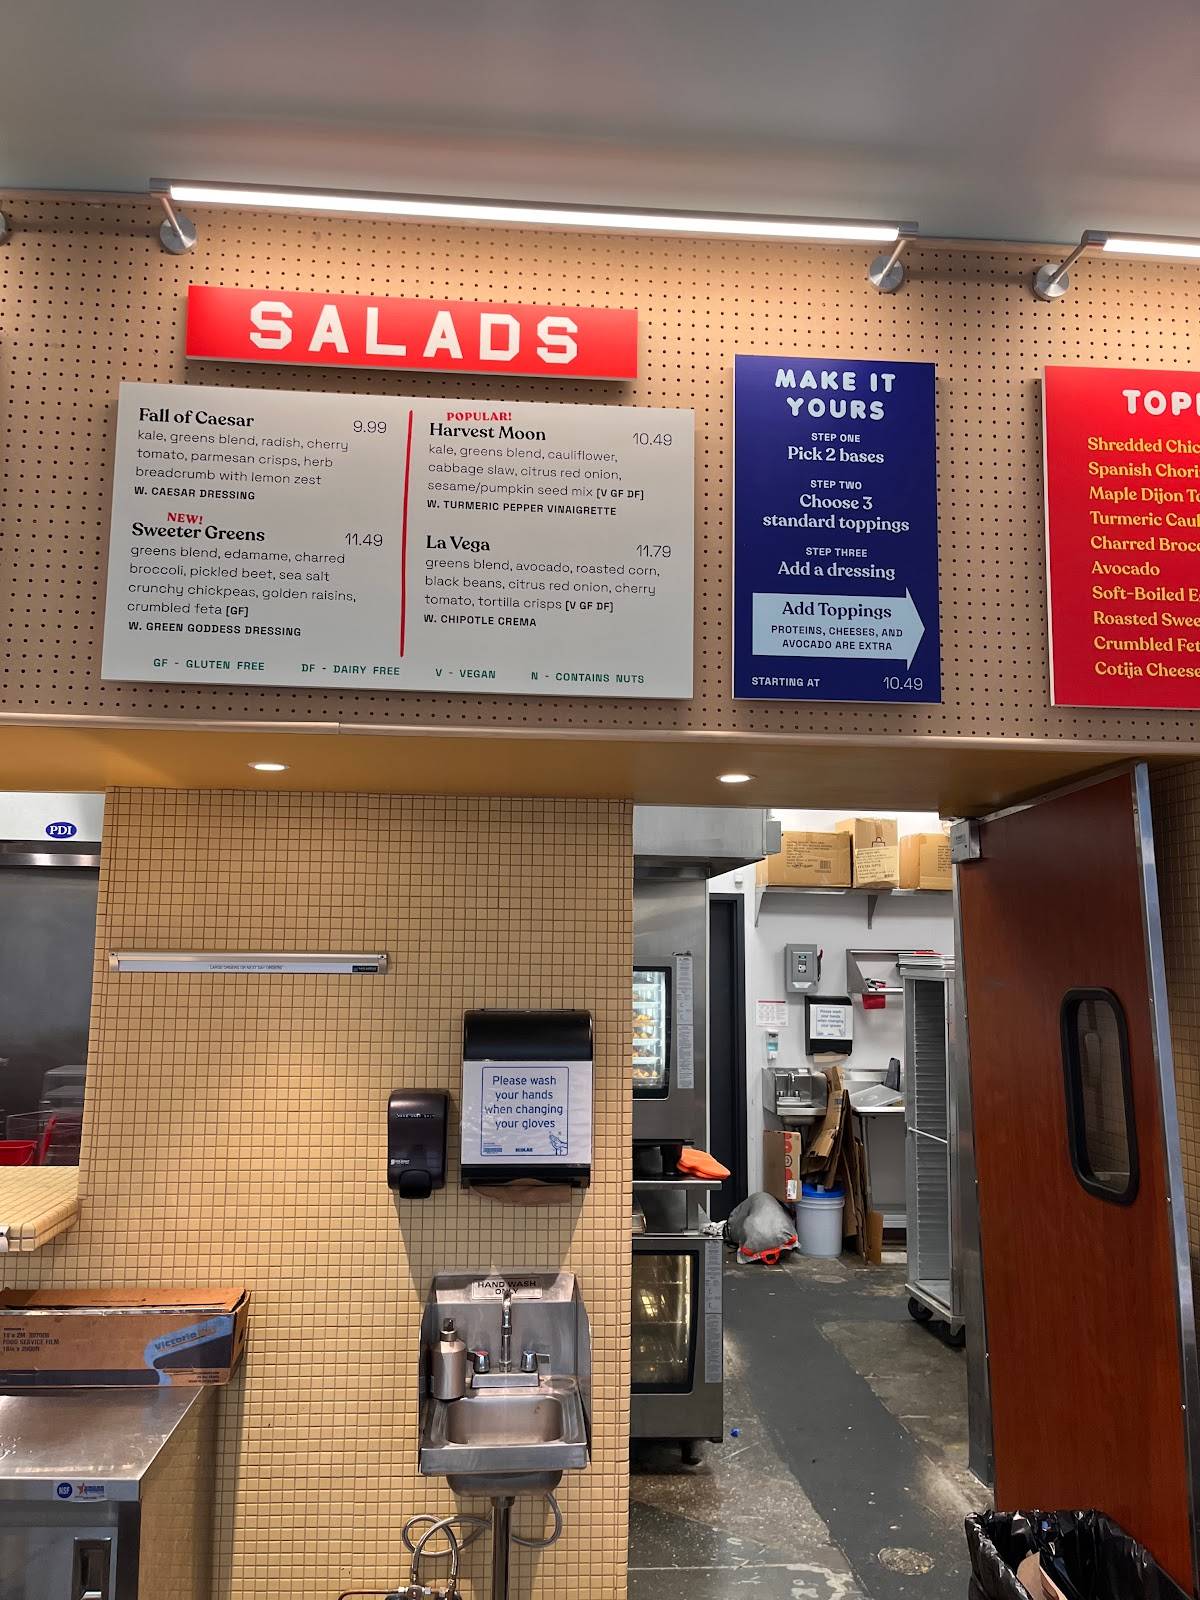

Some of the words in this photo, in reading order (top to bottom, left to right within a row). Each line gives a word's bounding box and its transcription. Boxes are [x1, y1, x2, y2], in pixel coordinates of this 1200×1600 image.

[249, 301, 578, 364] SALADS
[775, 368, 856, 391] MAKE
[870, 373, 896, 393] IT
[786, 398, 885, 420] YOURS
[1122, 389, 1200, 416] TOP
[139, 407, 169, 423] Fall
[174, 409, 193, 424] of
[195, 411, 254, 427] Caesar
[447, 412, 512, 421] POPULAR!
[353, 420, 387, 433] 9.99
[430, 423, 494, 438] Harvest
[498, 427, 546, 441] Moon
[138, 430, 167, 443] kale,
[170, 433, 215, 447] greens
[218, 435, 259, 447] blend,
[261, 438, 304, 449] radish,
[307, 440, 349, 452] cherry
[632, 432, 672, 446] 10.49
[811, 432, 837, 443] STEP
[840, 434, 860, 443] ONE
[1088, 437, 1163, 453] Shredded
[137, 449, 188, 462] tomato,
[191, 452, 255, 465] parmesan
[258, 455, 301, 467] crisps,
[304, 457, 333, 468] herb
[429, 444, 457, 457] kale,
[460, 447, 503, 460] greens
[506, 448, 545, 459] blend,
[548, 450, 618, 463] cauliflower,
[787, 446, 822, 462] Pick
[840, 448, 884, 464] bases
[135, 466, 216, 481] breadcrumb
[219, 470, 248, 481] with
[251, 471, 291, 484] lemon
[294, 474, 322, 485] zest
[428, 462, 484, 477] cabbage
[487, 465, 518, 476] slaw,
[521, 466, 557, 478] citrus
[560, 468, 581, 478] red
[584, 470, 622, 481] onion,
[1088, 462, 1152, 479] Spanish
[1155, 464, 1200, 479] Chori
[428, 481, 534, 496] sesame/pumpkin
[538, 486, 568, 495] seed
[571, 487, 593, 497] mix
[810, 479, 837, 489] STEP
[838, 480, 862, 490] TWO
[151, 487, 196, 497] CAESAR
[200, 489, 255, 500] DRESSING
[1089, 486, 1137, 504] Maple
[1141, 489, 1184, 506] Dijon
[443, 500, 500, 511] TURMERIC
[503, 503, 544, 512] PEPPER
[547, 504, 617, 516] VINAIGRETTE
[799, 494, 859, 510] Choose
[167, 512, 203, 525] NEW!
[762, 514, 835, 530] standard
[839, 516, 910, 532] toppings
[1090, 511, 1162, 527] Turmeric
[132, 522, 202, 539] Sweeter
[205, 526, 265, 542] Greens
[345, 532, 383, 547] 11.49
[426, 535, 446, 550] La
[450, 536, 490, 552] Vega
[636, 544, 672, 558] 11.79
[1090, 536, 1155, 552] Charred
[130, 545, 177, 558] greens
[180, 546, 222, 560] blend,
[224, 549, 291, 563] edamame,
[295, 552, 345, 564] charred
[806, 547, 832, 557] STEP
[835, 548, 867, 558] THREE
[129, 564, 186, 577] broccoli,
[190, 566, 239, 579] pickled
[242, 568, 276, 580] beet,
[279, 570, 303, 581] sea
[306, 570, 330, 582] salt
[426, 558, 470, 570] greens
[473, 559, 513, 572] blend,
[516, 562, 573, 574] avocado,
[576, 564, 625, 576] roasted
[628, 566, 660, 577] corn,
[778, 561, 810, 576] Add
[827, 562, 896, 581] dressing
[1092, 560, 1160, 576] Avocado
[128, 583, 184, 596] crunchy
[187, 584, 259, 599] chickpeas,
[262, 588, 309, 601] golden
[311, 590, 357, 602] raisins,
[425, 576, 459, 587] black
[462, 578, 505, 590] beans,
[508, 579, 546, 590] citrus
[549, 581, 570, 591] red
[573, 582, 612, 594] onion,
[614, 584, 656, 596] cherry
[1092, 585, 1184, 602] Soft-Boiled
[127, 602, 190, 614] crumbled
[194, 603, 222, 615] feta
[226, 606, 249, 618] [GF]
[425, 594, 476, 607] tomato,
[478, 597, 520, 608] tortilla
[523, 598, 562, 611] crisps
[782, 602, 815, 616] Add
[818, 602, 892, 620] Toppings
[1093, 611, 1158, 627] Roasted
[440, 615, 494, 625] CHIPOTLE
[498, 616, 536, 627] CREMA
[146, 622, 184, 633] GREEN
[187, 623, 241, 634] GODDESS
[245, 626, 301, 637] DRESSING
[771, 625, 826, 636] PROTEINS,
[829, 626, 879, 637] CHEESES,
[881, 627, 903, 637] AND
[782, 640, 832, 650] AVOCADO
[835, 641, 857, 650] ARE
[860, 642, 893, 651] EXTRA
[1094, 636, 1174, 652] Crumbled
[153, 658, 168, 667] GF
[186, 659, 230, 670] GLUTEN
[237, 661, 265, 671] FREE
[301, 664, 316, 672] DF
[333, 664, 366, 674] DAIRY
[373, 666, 400, 675] FREE
[1095, 661, 1143, 680] Cotija
[460, 670, 496, 678] VEGAN
[556, 672, 610, 682] CONTAINS
[616, 675, 644, 684] NUTS
[752, 676, 804, 687] STARTING
[807, 678, 820, 687] AT
[883, 676, 923, 690] 10.49
[50, 826, 72, 835] PDI
[492, 1076, 527, 1085] Please
[530, 1076, 556, 1085] wash
[496, 1092, 518, 1101] your
[522, 1090, 553, 1100] hands
[485, 1106, 512, 1114] when
[516, 1105, 563, 1116] changing
[495, 1120, 519, 1130] your
[522, 1119, 555, 1129] gloves
